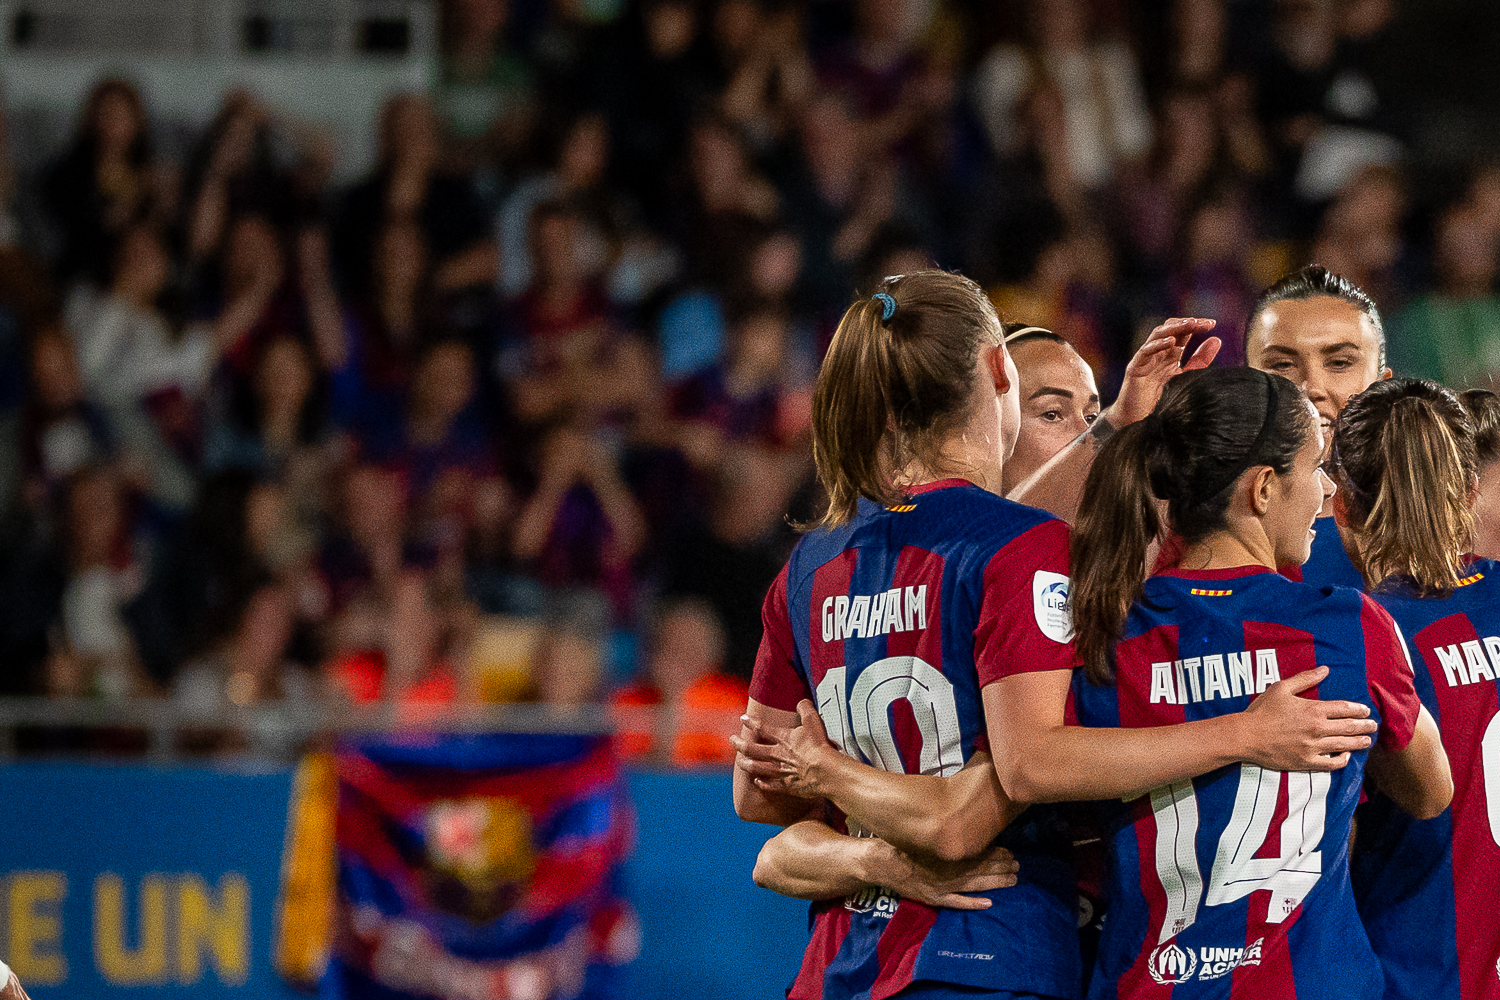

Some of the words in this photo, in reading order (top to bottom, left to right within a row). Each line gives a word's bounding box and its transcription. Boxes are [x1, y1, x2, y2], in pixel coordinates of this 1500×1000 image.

[821, 584, 928, 643] GRAHAM
[815, 655, 965, 778] 10
[1150, 648, 1281, 704] AITANA
[1150, 762, 1331, 946] 14
[92, 869, 252, 987] UN
